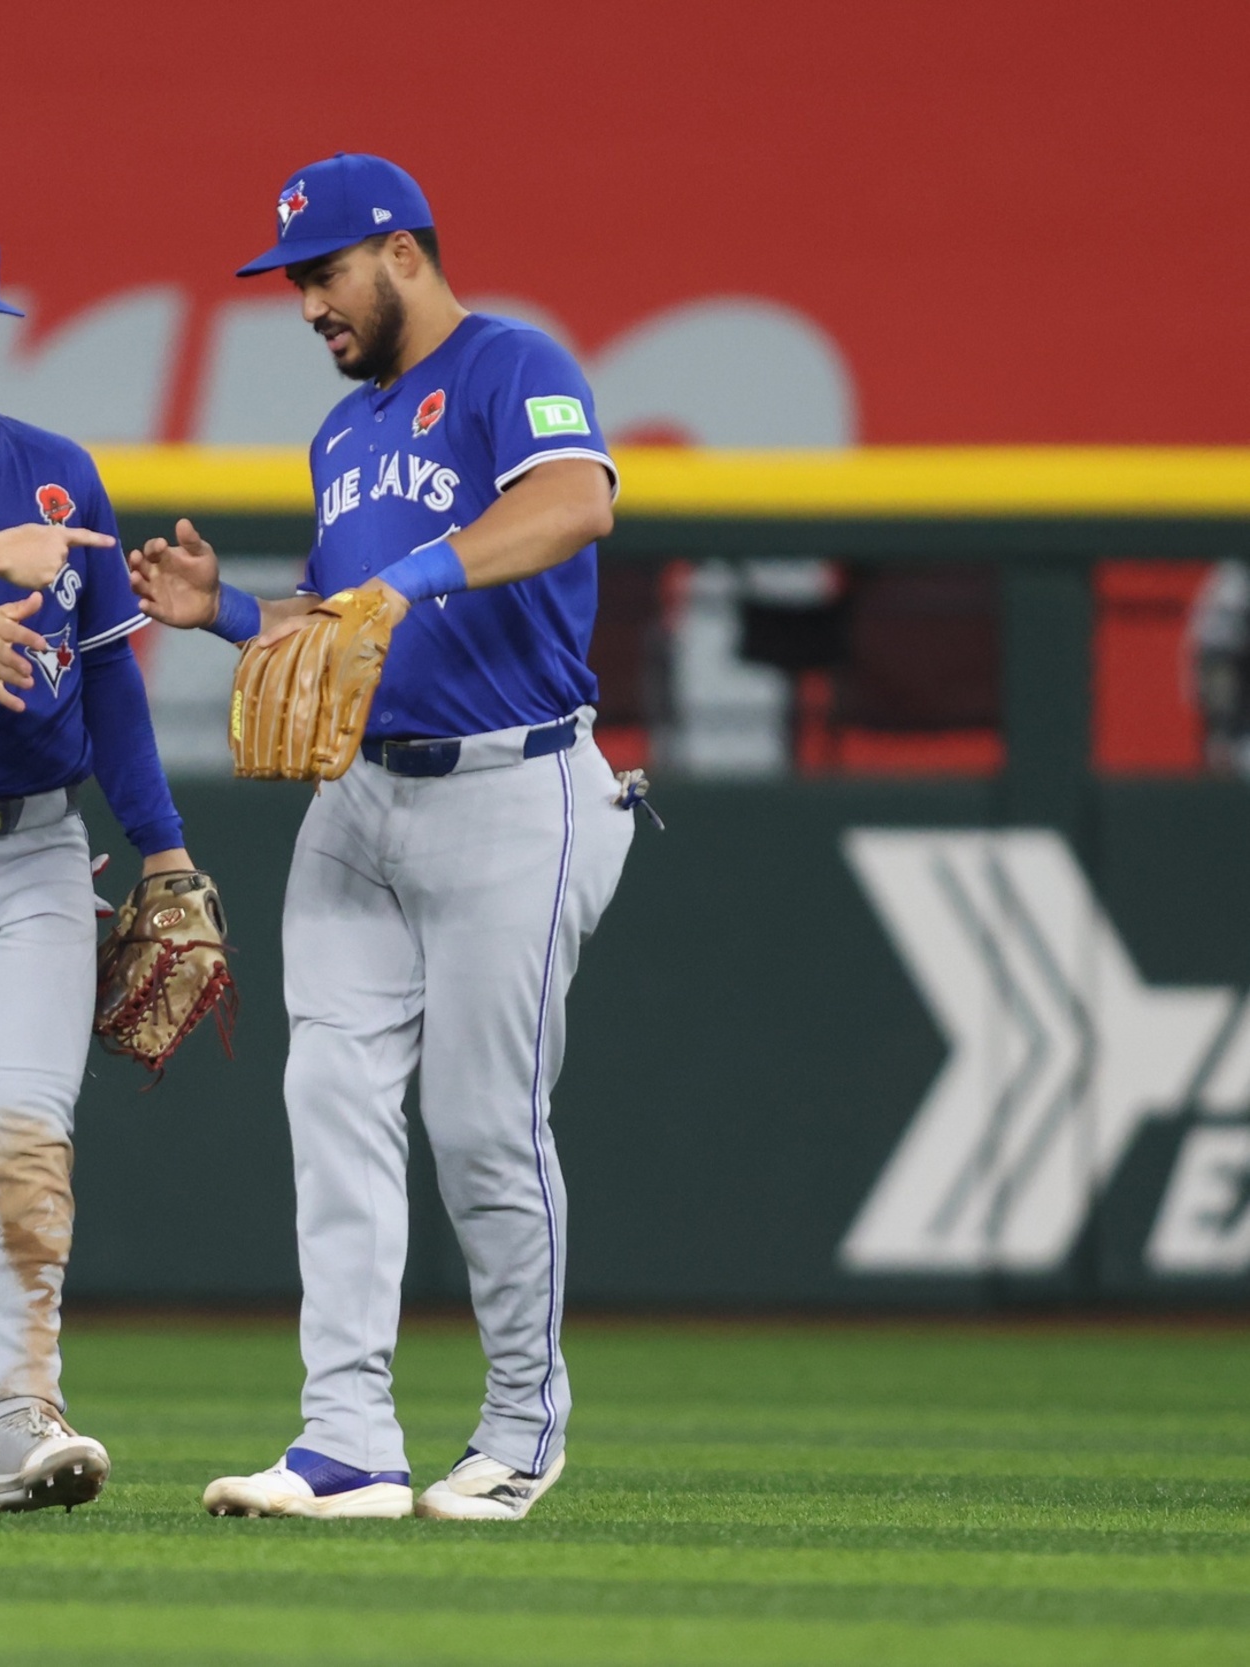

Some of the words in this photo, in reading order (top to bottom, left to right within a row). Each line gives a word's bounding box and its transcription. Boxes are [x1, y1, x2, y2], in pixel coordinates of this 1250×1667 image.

[534, 403, 579, 427] TD
[318, 466, 361, 544] UE
[369, 450, 461, 513] JAYS
